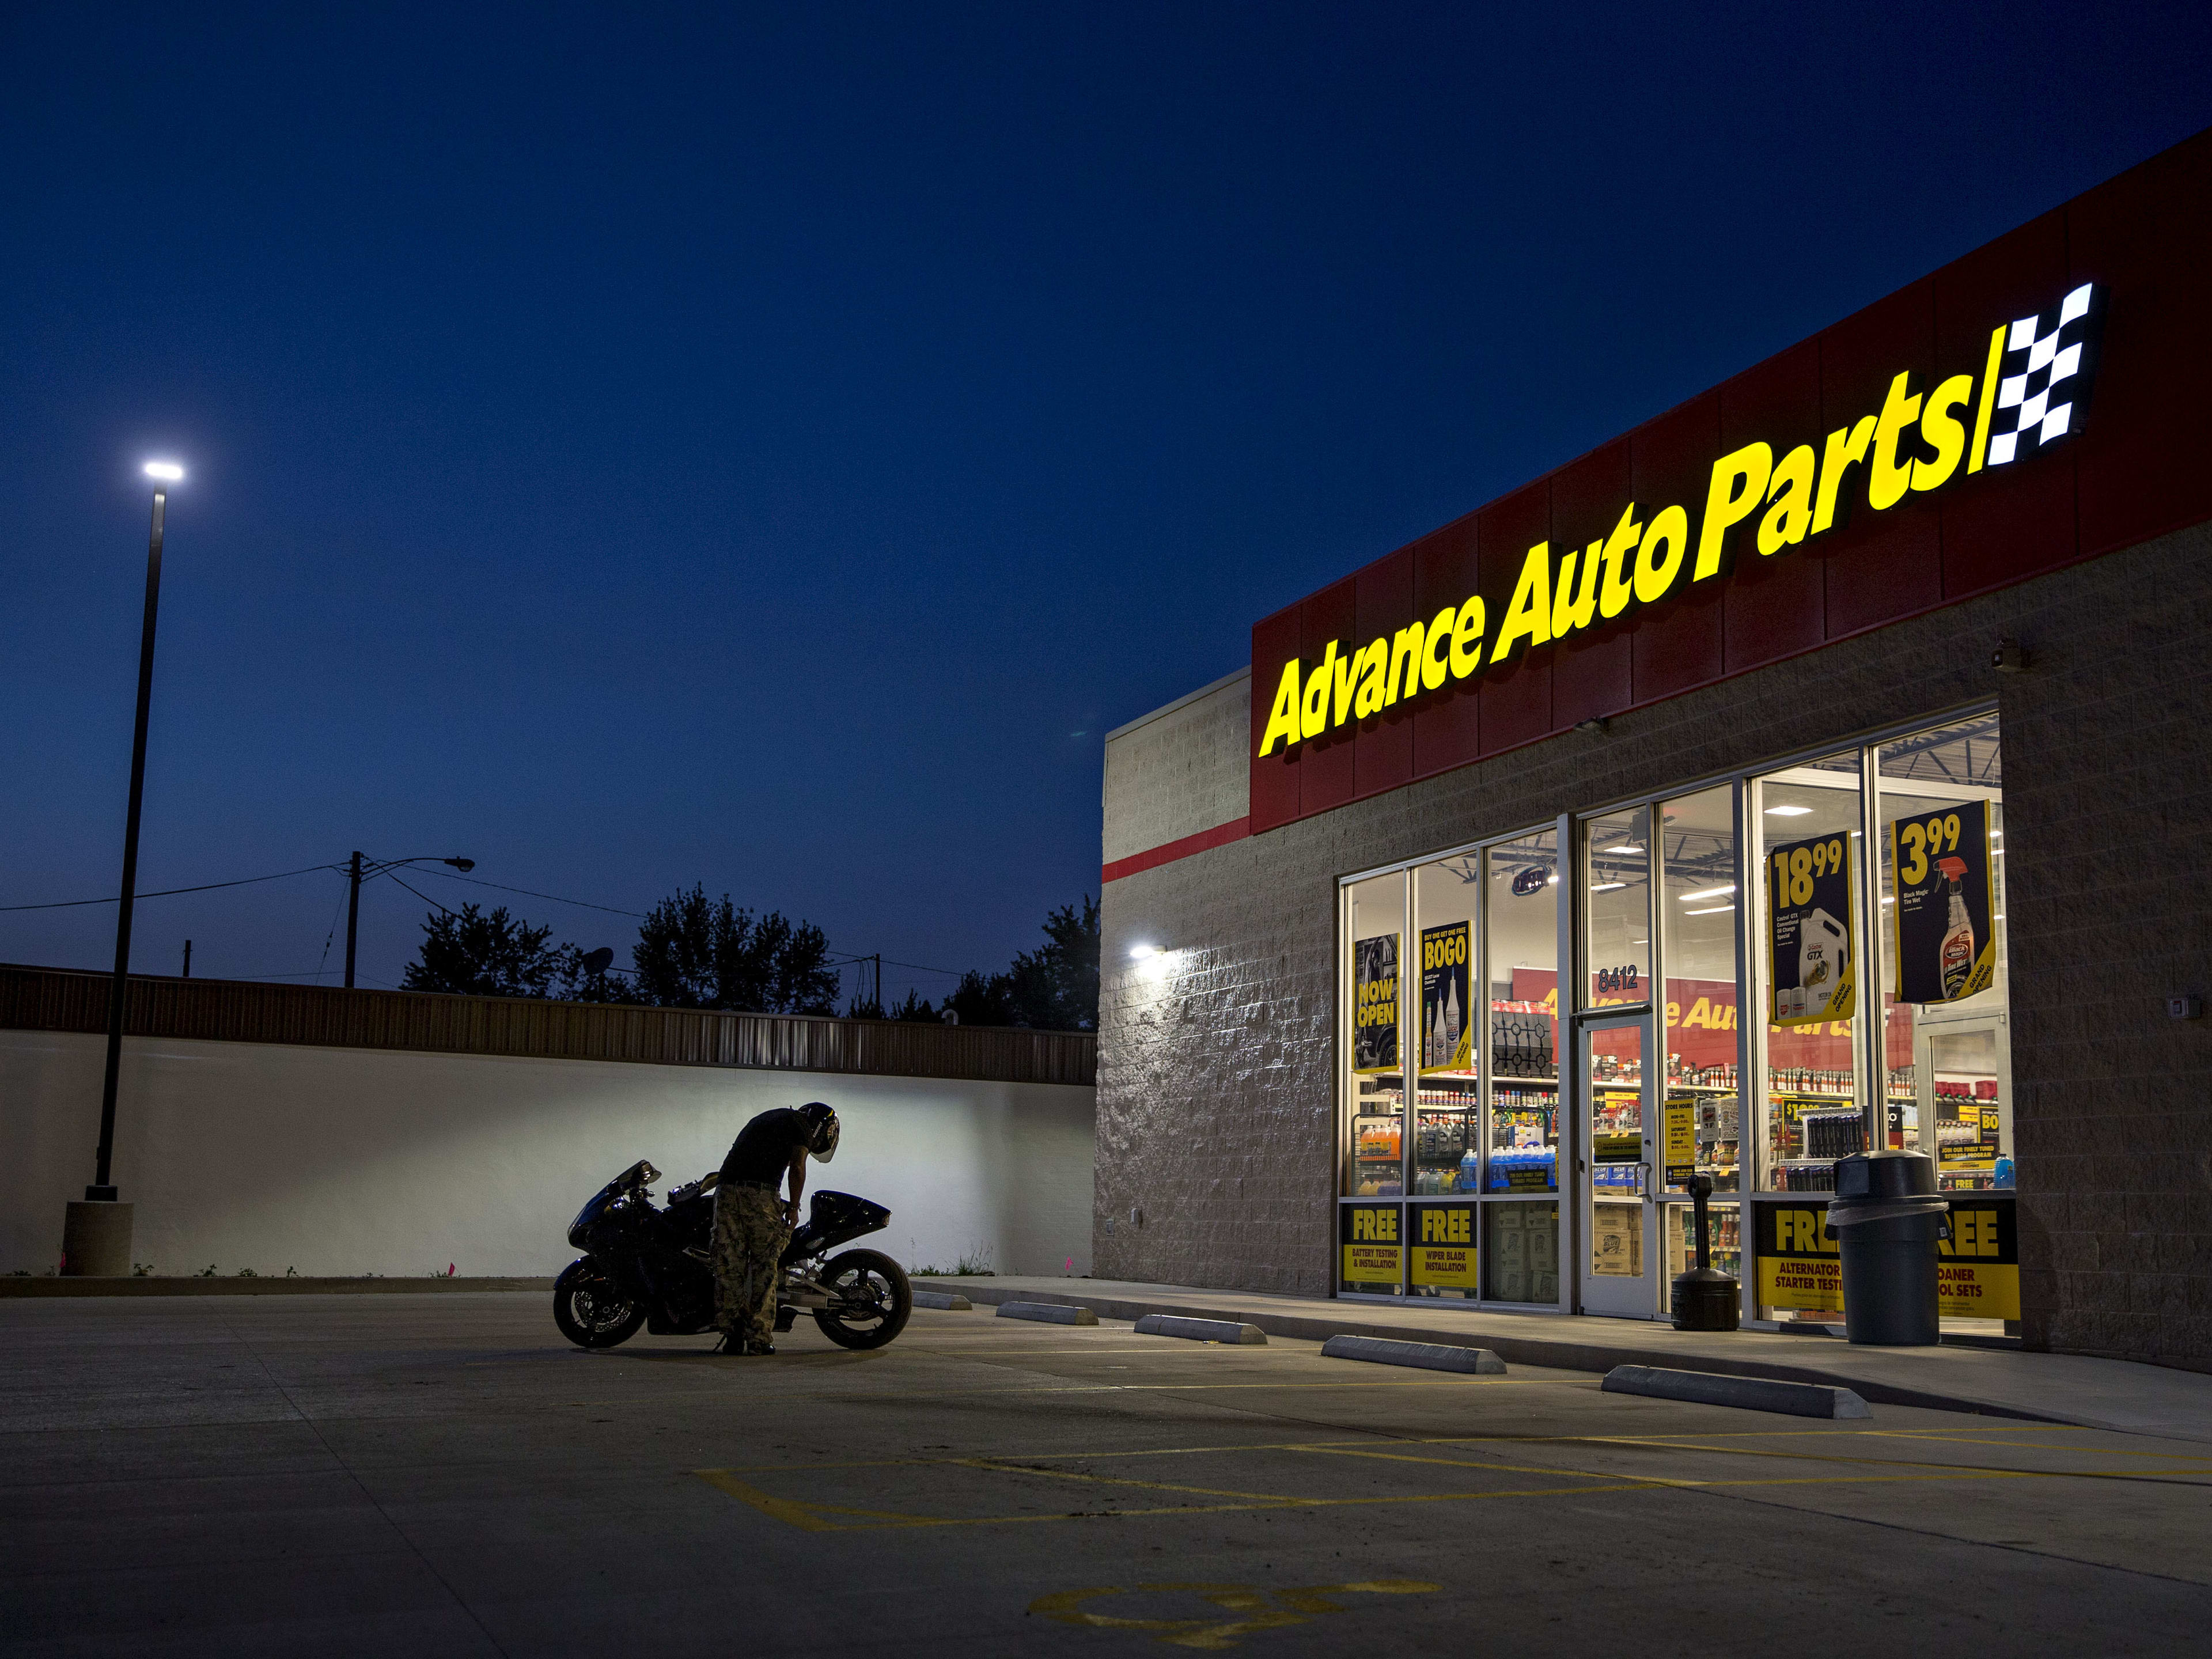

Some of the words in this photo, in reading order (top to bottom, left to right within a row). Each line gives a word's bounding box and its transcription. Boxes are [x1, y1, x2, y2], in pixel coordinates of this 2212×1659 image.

[1258, 594, 1485, 757] Advance
[1488, 502, 1688, 664] Auto
[1694, 370, 1972, 583] Parts
[1777, 919, 1798, 927] Conventional
[1425, 935, 1466, 971] BOGO
[1808, 950, 1823, 960] GTX
[1949, 945, 1965, 953] Black
[1599, 964, 1638, 993] 8412
[1969, 964, 1984, 988] GRAND
[1972, 965, 1992, 994] OPENING
[1359, 978, 1393, 1003] NOW
[1832, 983, 1846, 1006] GRAND
[1835, 984, 1852, 1012] OPENING
[1358, 1002, 1394, 1028] OPEN
[1456, 1041, 1465, 1058] GRAND
[1458, 1043, 1468, 1064] OPENING
[1955, 1179, 1974, 1188] FREE
[1354, 1210, 1396, 1240] FREE
[1422, 1210, 1470, 1243] FREE
[1776, 1210, 1839, 1252] FRE
[1353, 1248, 1374, 1256] BATTERY
[1376, 1249, 1397, 1258] TESTING
[1426, 1251, 1445, 1260] WIPER
[1446, 1251, 1465, 1260] BLADE
[1353, 1259, 1358, 1267] &
[1359, 1259, 1396, 1268] INSTALLATION
[1425, 1262, 1467, 1272] INSTALLATION
[1779, 1262, 1840, 1276] ALTERNATOR
[1775, 1276, 1815, 1289] STARTER
[1817, 1278, 1842, 1291] TESTI
[1938, 1268, 1975, 1281] OANER
[1939, 1283, 1954, 1296] OL
[1956, 1285, 1982, 1297] SETS
